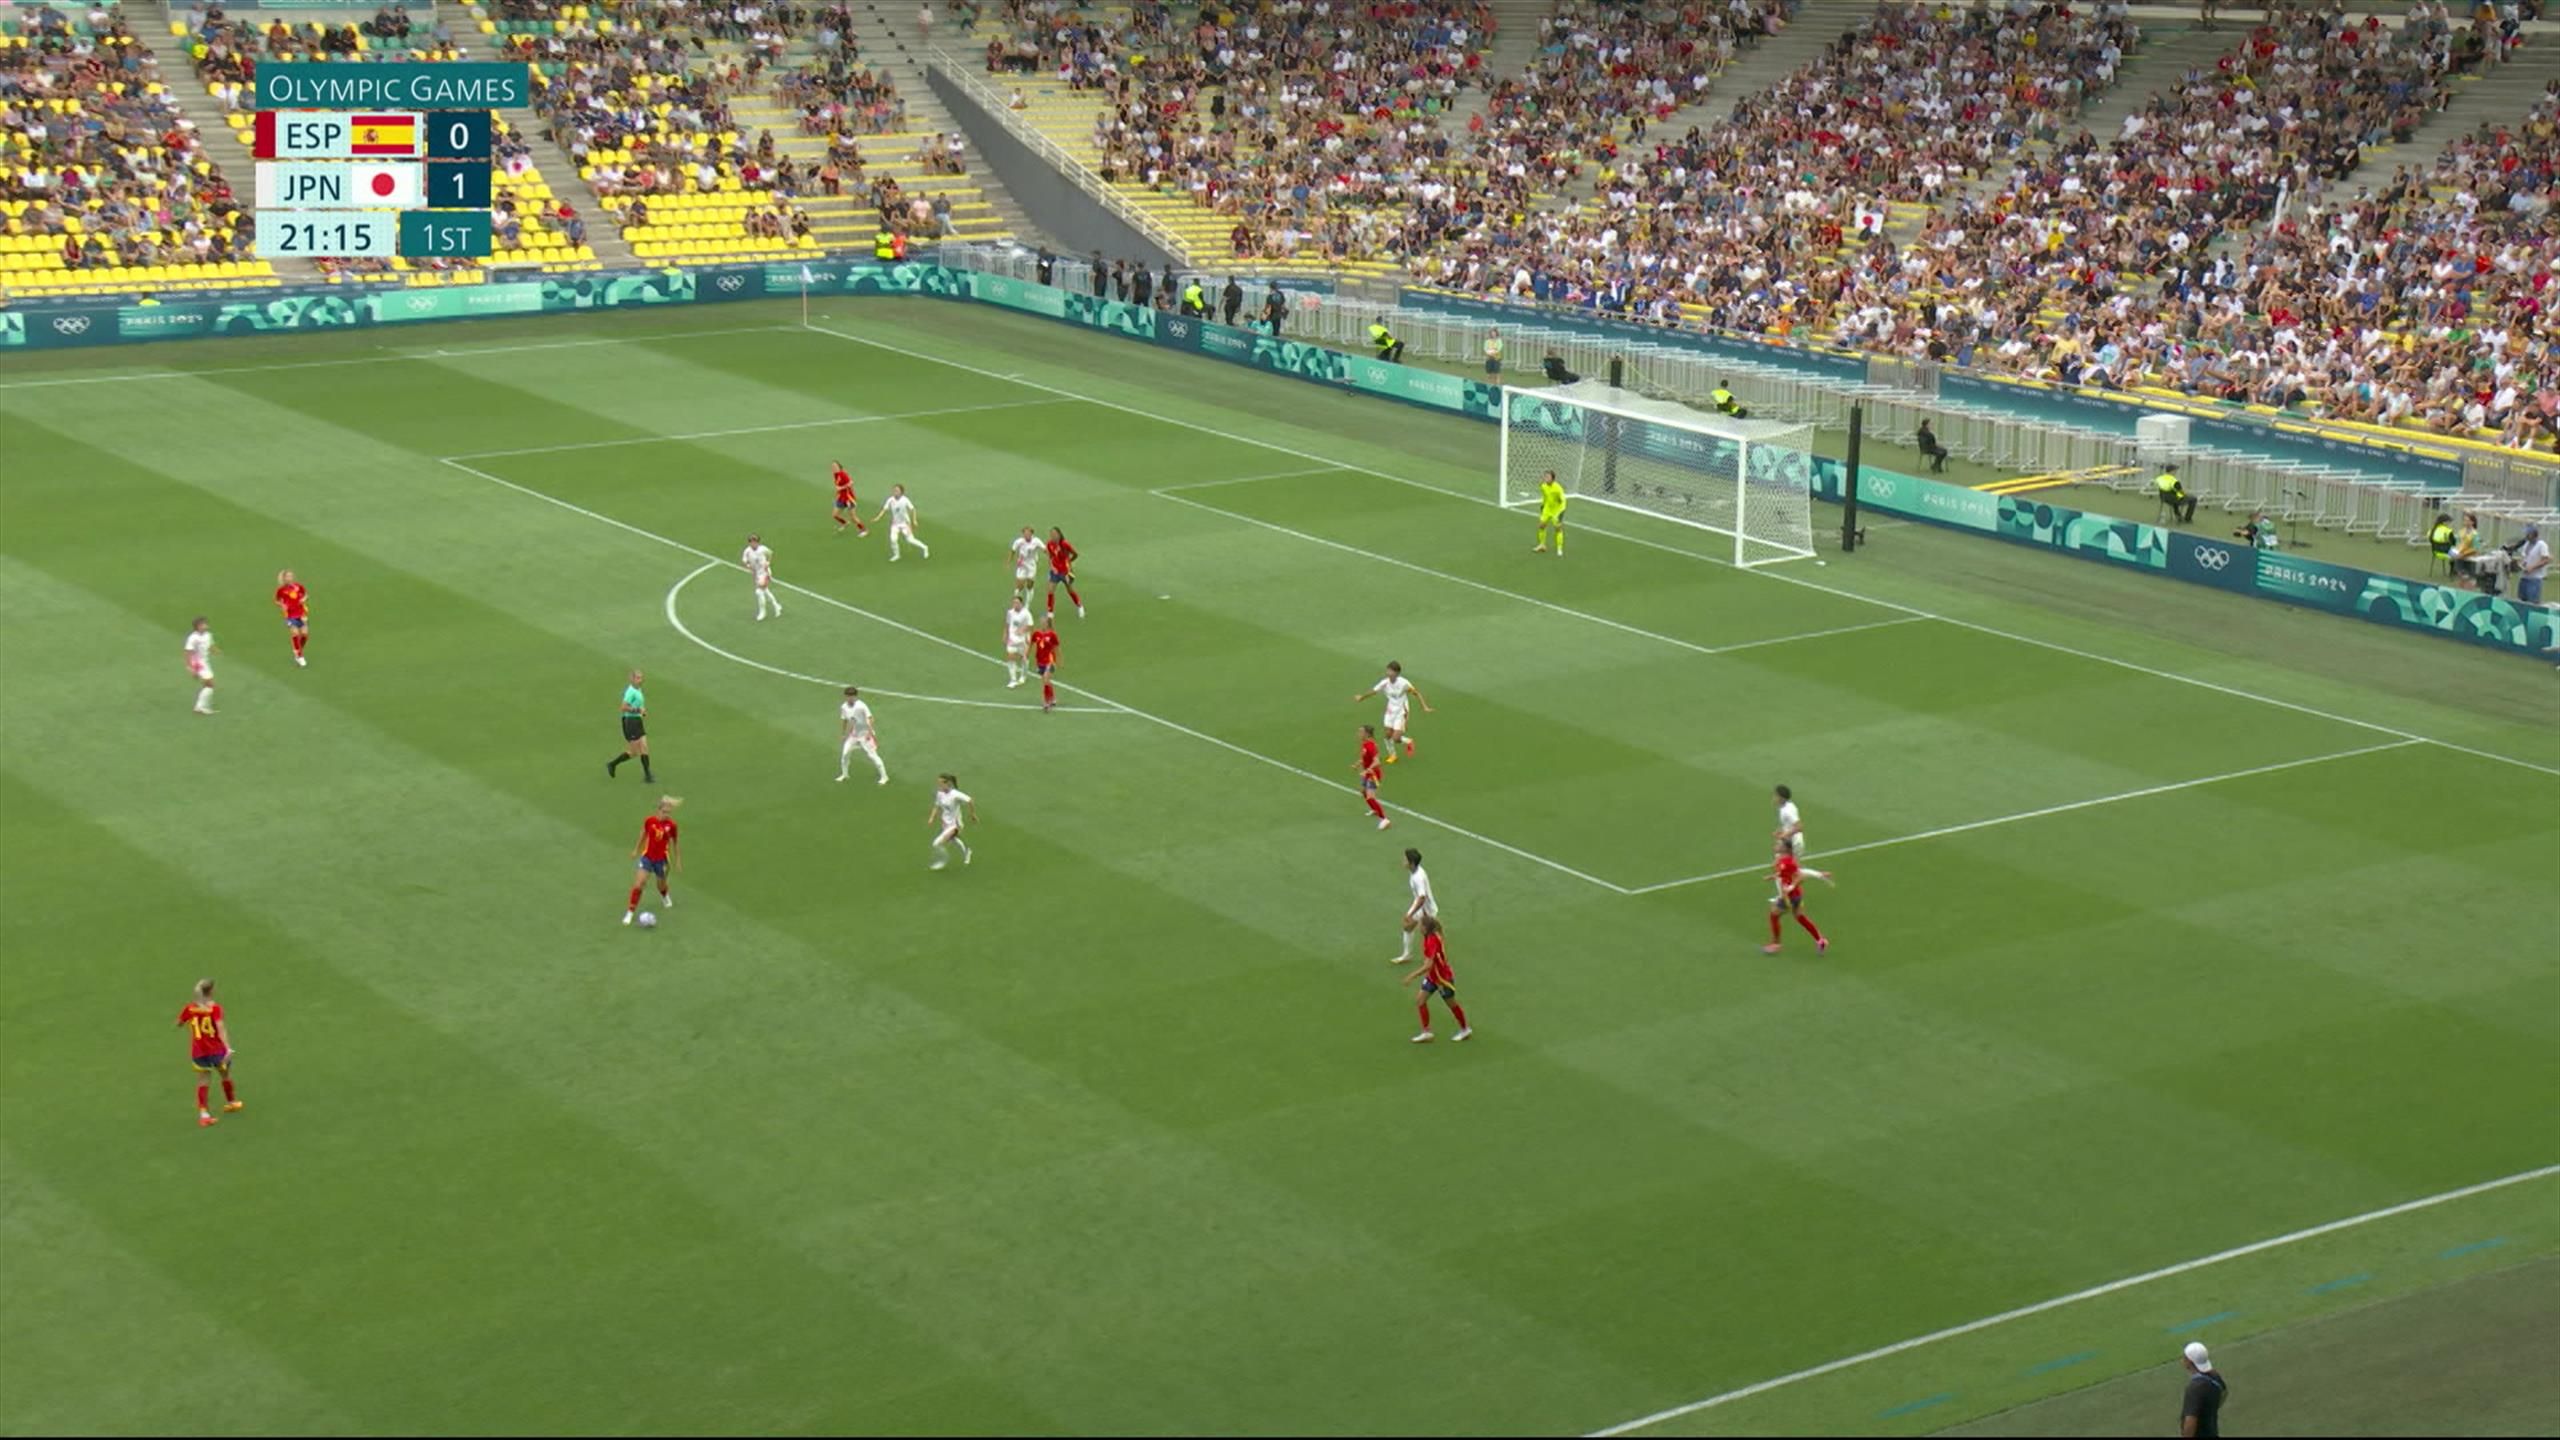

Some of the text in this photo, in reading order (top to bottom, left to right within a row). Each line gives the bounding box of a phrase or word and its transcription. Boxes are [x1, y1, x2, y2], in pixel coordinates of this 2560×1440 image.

[2263, 564, 2347, 592] PARIS 2024
[190, 1016, 215, 1040] 14
